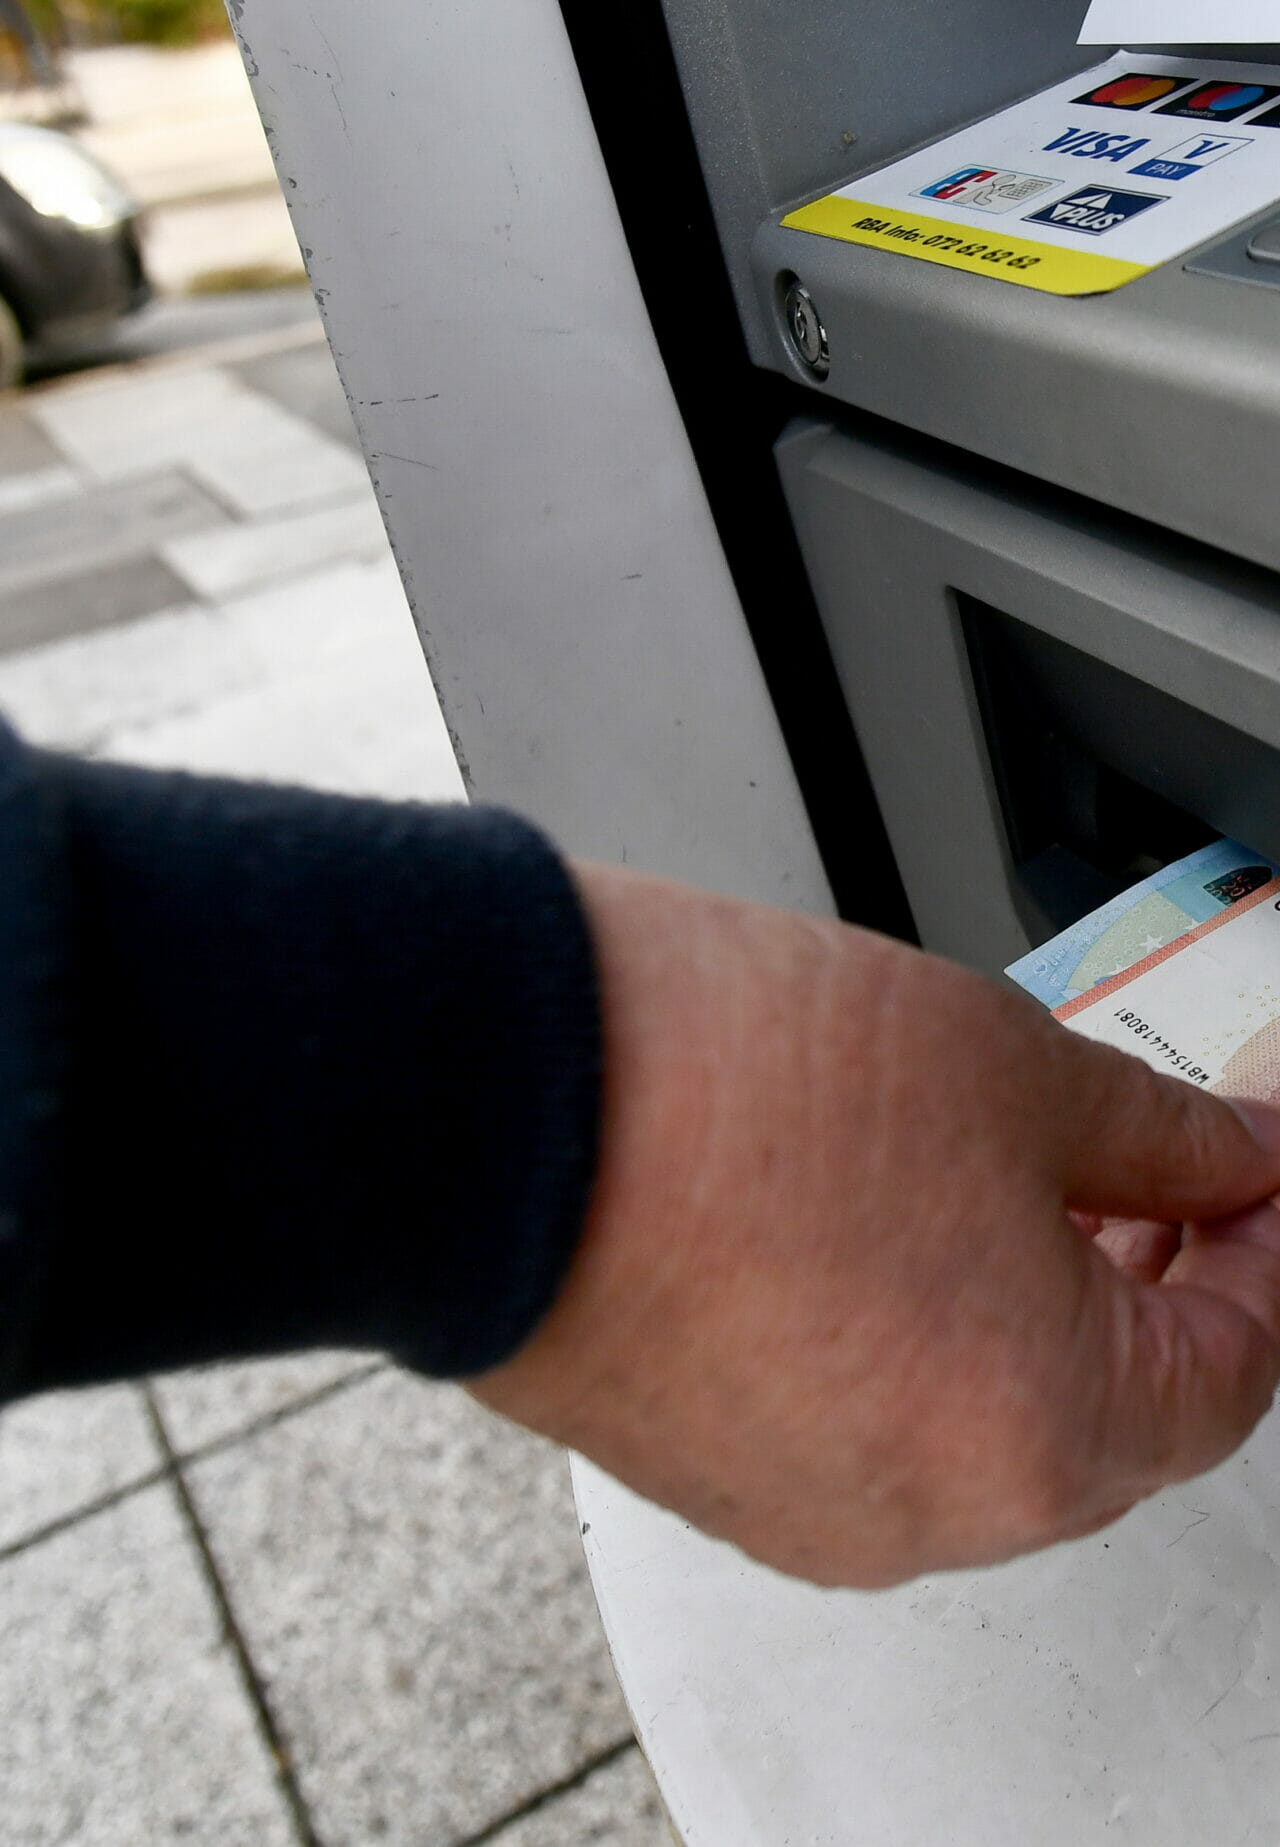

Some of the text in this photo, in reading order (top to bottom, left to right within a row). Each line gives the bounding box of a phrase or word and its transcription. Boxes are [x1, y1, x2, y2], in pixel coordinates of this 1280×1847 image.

[1042, 126, 1153, 163] VISA
[1148, 162, 1186, 178] PAY
[1063, 208, 1125, 230] PLUS
[851, 217, 1041, 269] RBA Info: 072 62 62 62
[1113, 1007, 1210, 1084] WB1544418081
